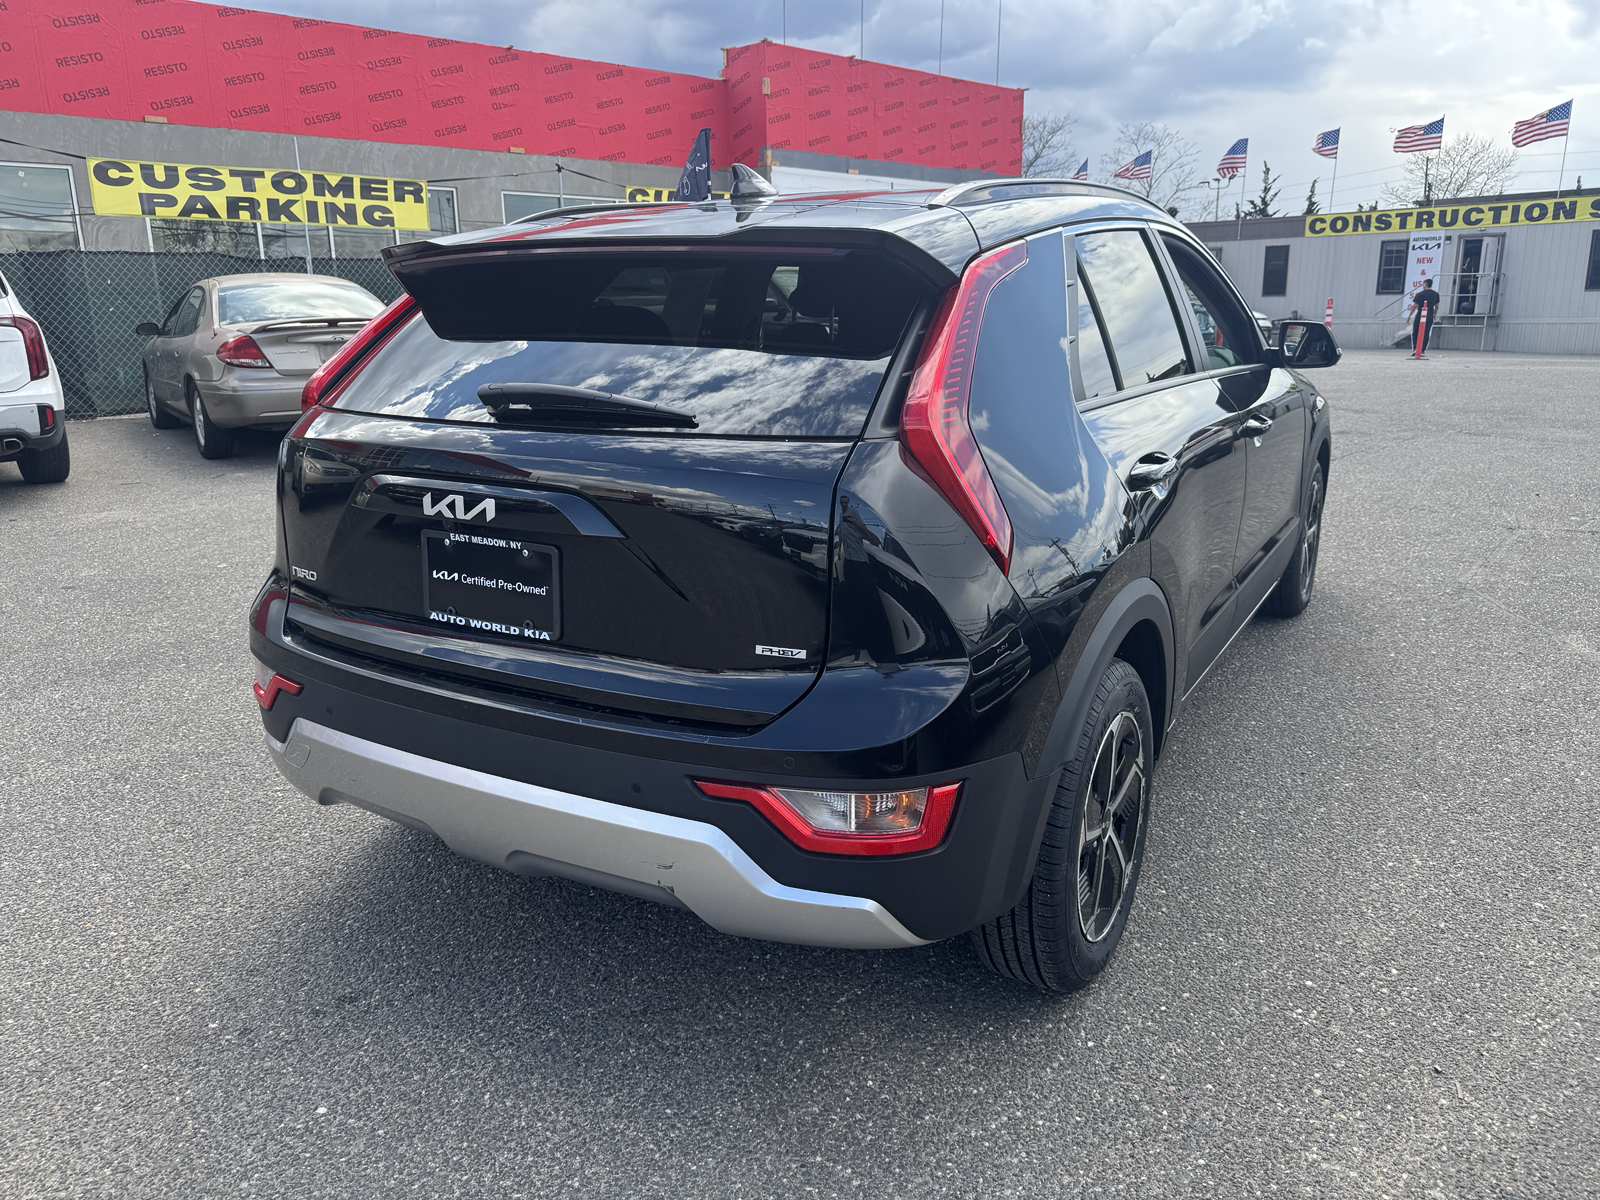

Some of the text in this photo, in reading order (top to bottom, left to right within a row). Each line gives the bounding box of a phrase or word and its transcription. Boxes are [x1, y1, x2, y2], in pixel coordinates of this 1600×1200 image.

[217, 7, 257, 18] RESIS
[52, 14, 100, 28] RESISTO
[142, 26, 186, 40] RESISTO
[223, 37, 263, 50] RESISTO
[56, 52, 103, 68] RESISTO
[298, 47, 336, 60] RESISTO
[489, 54, 519, 66] RESISTO
[144, 62, 188, 78] RESISTO
[367, 57, 402, 70] RESISTO
[545, 64, 573, 74] RESISTO
[431, 65, 464, 78] RESISTO
[597, 70, 624, 81] RESISTO
[224, 72, 264, 86] RESISTO
[646, 77, 670, 87] RESISTO
[63, 87, 110, 102] RESISTO
[300, 81, 336, 95] RESISTO
[490, 84, 520, 96] RESISTO
[691, 84, 714, 93] RESISTO
[368, 90, 403, 102] RESISTO
[432, 96, 464, 109] RESISTO
[545, 92, 573, 104] RESISTO
[150, 96, 194, 111] RESISTO
[596, 98, 623, 110] RESISTO
[645, 104, 670, 114] RESISTO
[230, 104, 270, 118] RESISTO
[304, 112, 341, 126] RESISTO
[373, 118, 407, 132] RESISTO
[548, 118, 576, 132] RESISTO
[435, 124, 467, 138] RESISTO
[492, 128, 522, 140] RESISTO
[599, 124, 626, 136] RESISTO
[647, 128, 672, 140] RESISTO
[92, 160, 425, 204] CUSTOMER
[138, 192, 395, 228] PARKING
[1309, 200, 1578, 235] CONSTRUCTION
[422, 491, 496, 523] KIA
[450, 533, 469, 543] EAST
[510, 541, 522, 550] NY
[292, 565, 318, 581] NIRO
[432, 569, 459, 581] KIA
[461, 573, 496, 588] Certified
[429, 611, 550, 641] AUTO WORLD KIA
[761, 647, 801, 657] PHEV
